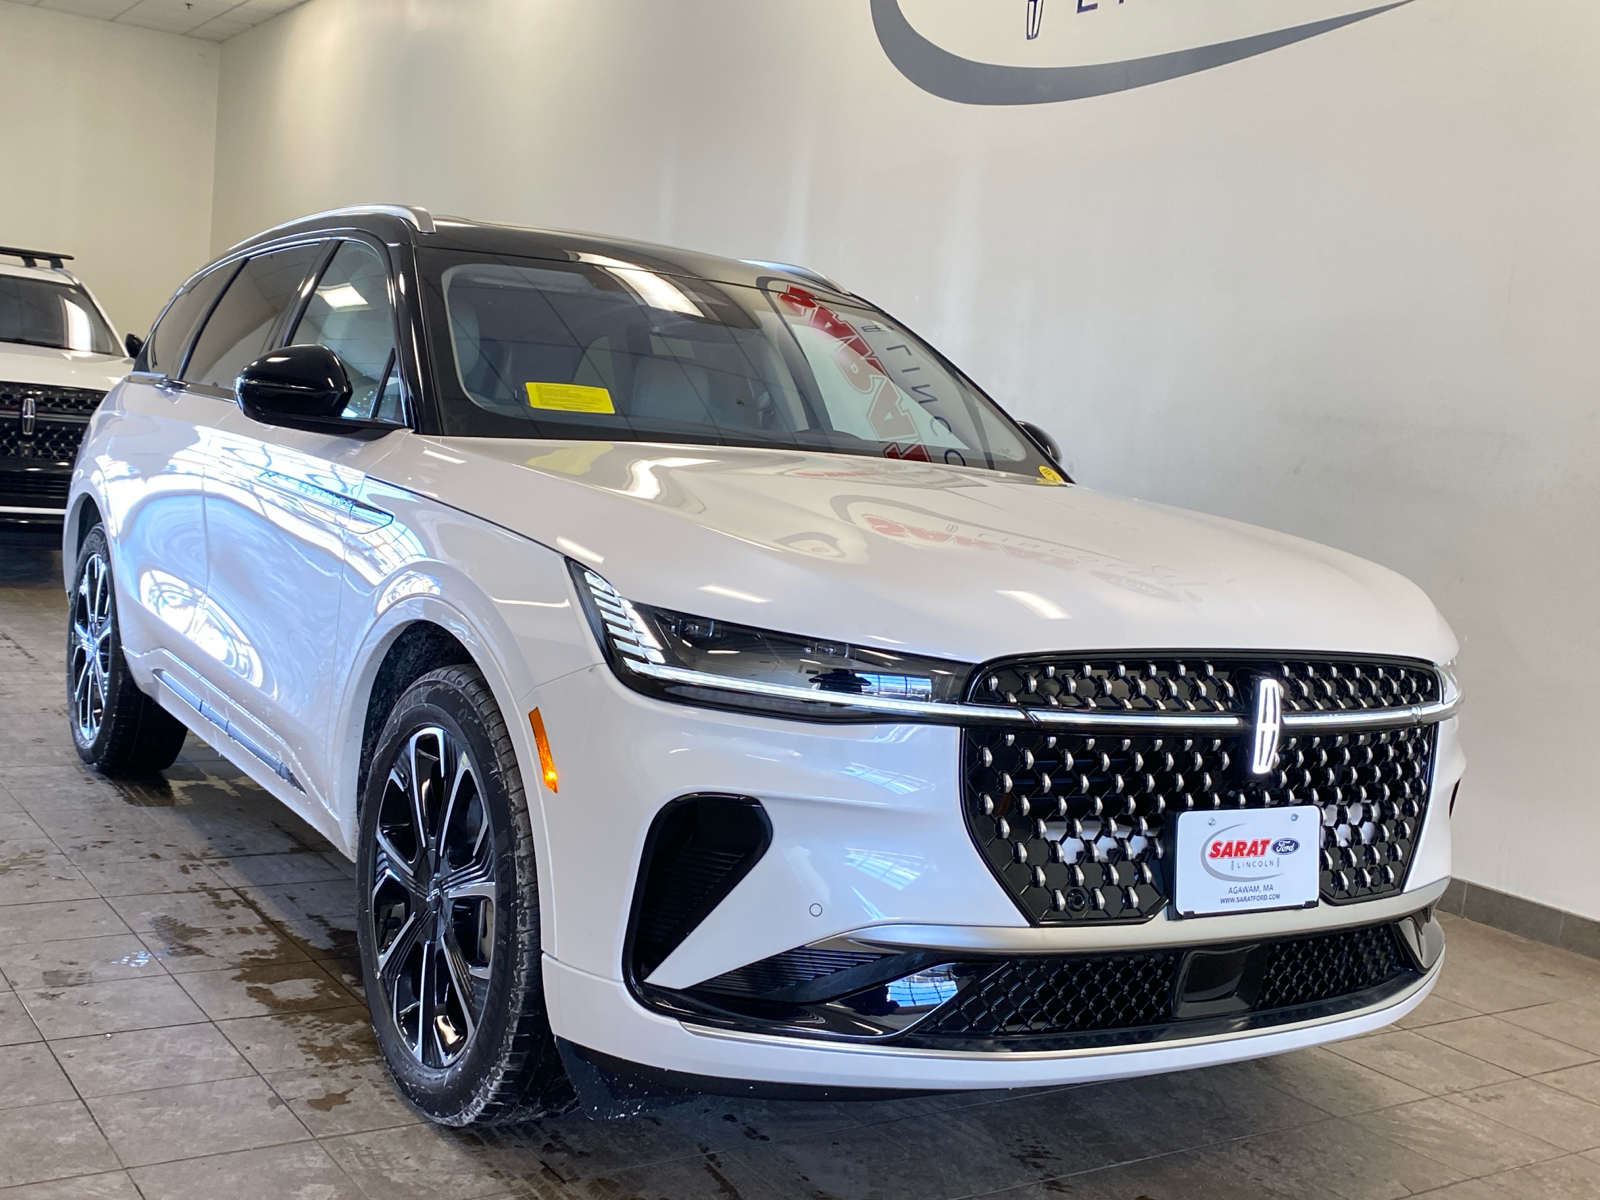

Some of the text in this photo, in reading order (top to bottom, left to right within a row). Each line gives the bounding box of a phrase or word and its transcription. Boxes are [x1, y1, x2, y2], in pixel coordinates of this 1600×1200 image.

[1208, 838, 1297, 859] SARAT Ford
[1237, 860, 1274, 869] LINCOLN
[1228, 884, 1274, 895] AGAWAM, MA
[1220, 894, 1281, 904] WWW.SARATFORD.COM
